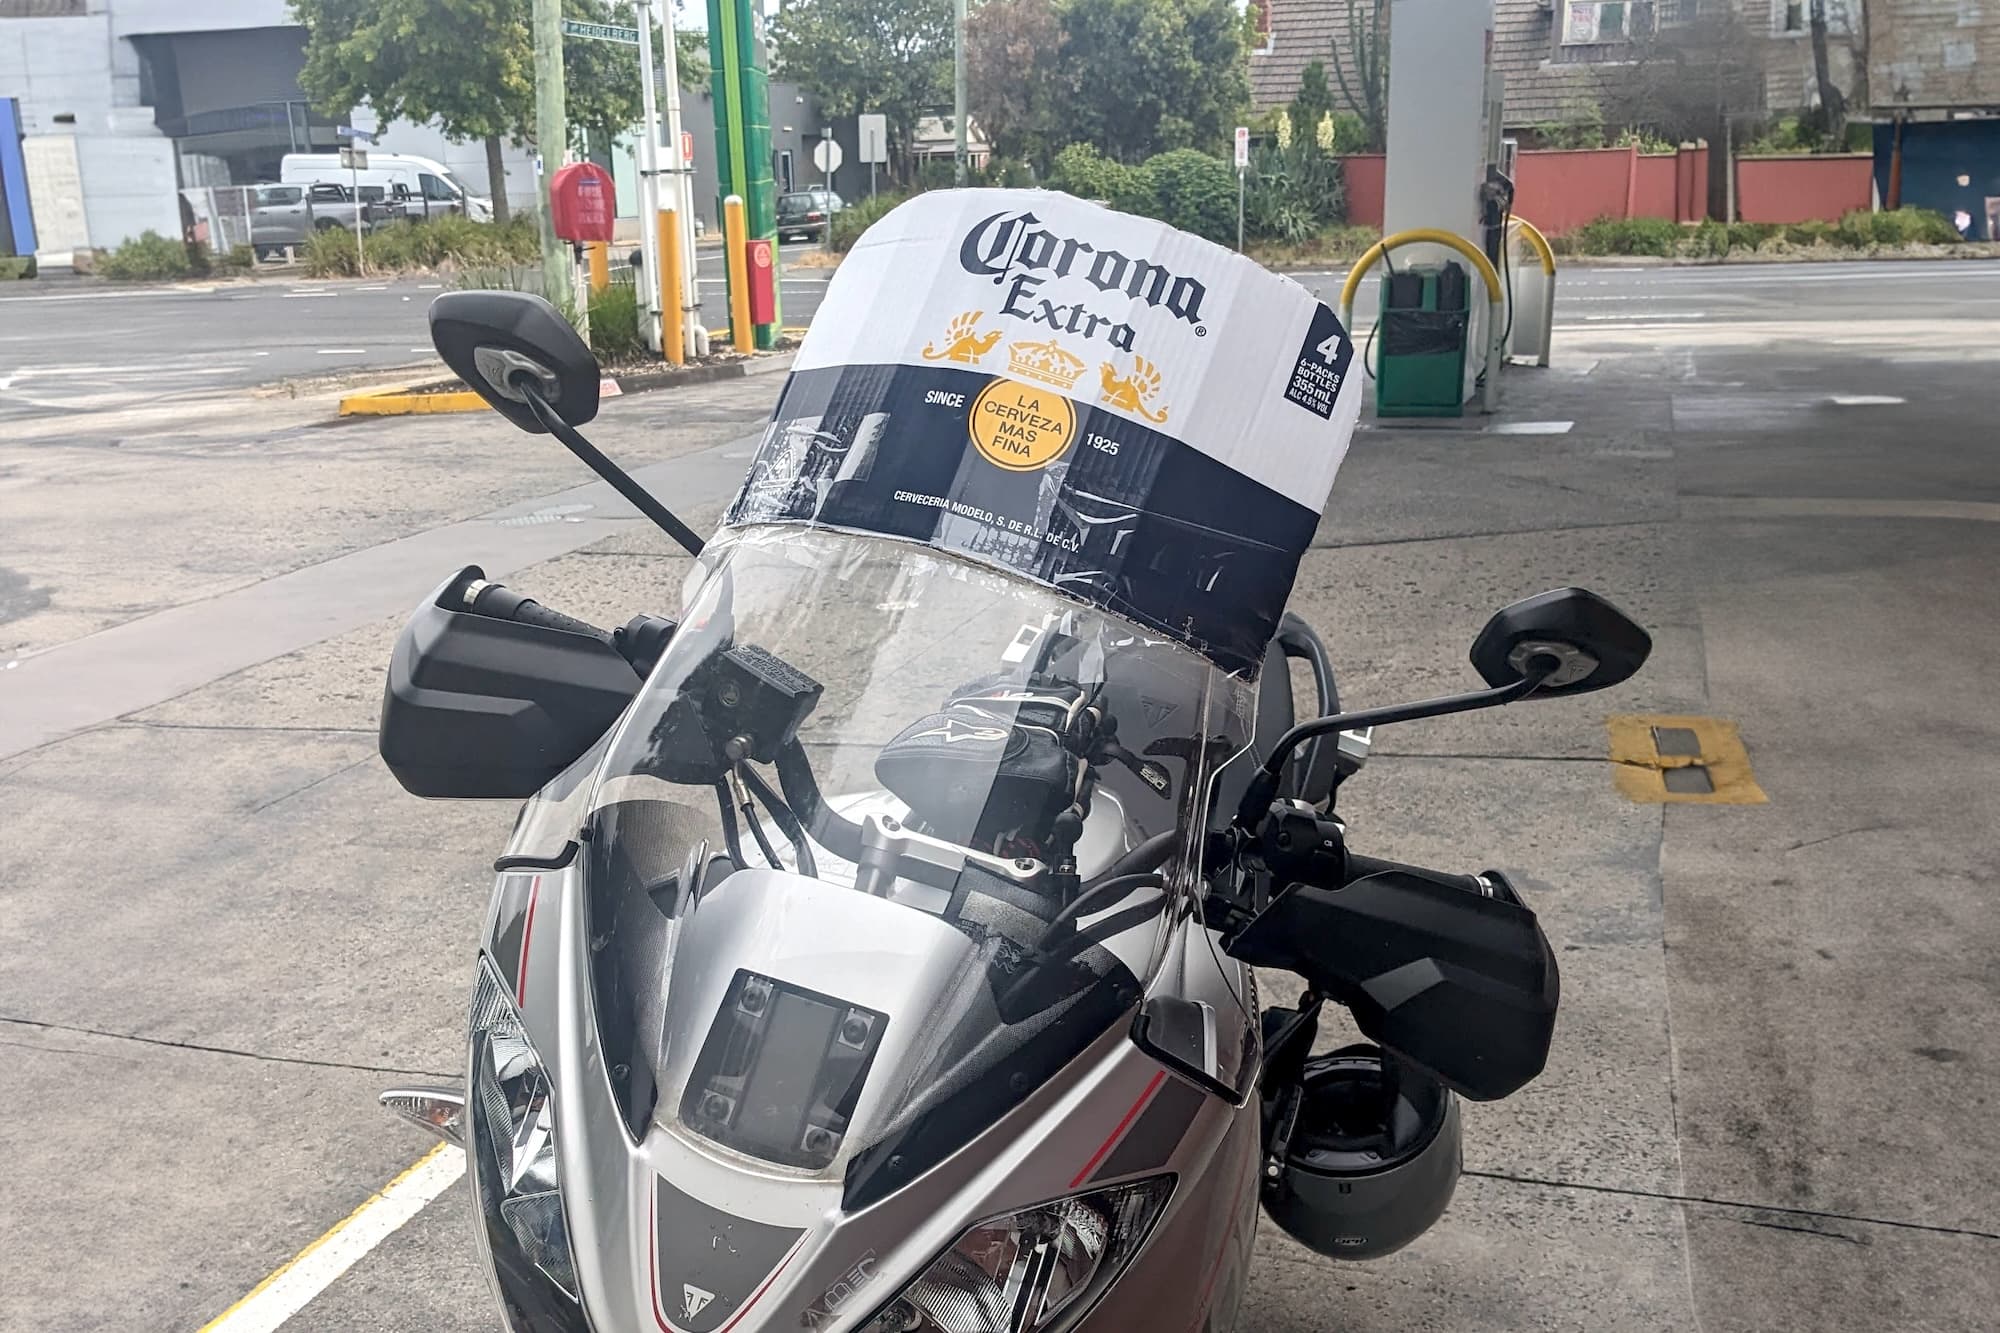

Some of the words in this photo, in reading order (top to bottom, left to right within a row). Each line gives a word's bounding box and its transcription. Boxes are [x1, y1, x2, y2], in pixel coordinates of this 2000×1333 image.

[959, 211, 1207, 325] Corona
[999, 273, 1136, 352] Extra
[1316, 334, 1341, 365] 4
[1297, 366, 1337, 392] BOTTLES
[1300, 358, 1340, 384] 6-PACKS
[924, 390, 965, 408] SINCE
[1016, 395, 1040, 412] LA
[1289, 387, 1302, 400] ALC
[1316, 402, 1328, 414] VOL
[984, 400, 1062, 435] CERVEZA
[998, 421, 1038, 443] MAS
[1085, 432, 1120, 456] 1925
[992, 434, 1031, 458] FINA
[894, 490, 950, 509] CERVECERIA
[951, 502, 994, 525] MODELO,
[996, 515, 1006, 528] S.
[1008, 519, 1023, 532] DE
[1023, 524, 1042, 539] R.L.
[1045, 532, 1060, 546] DE
